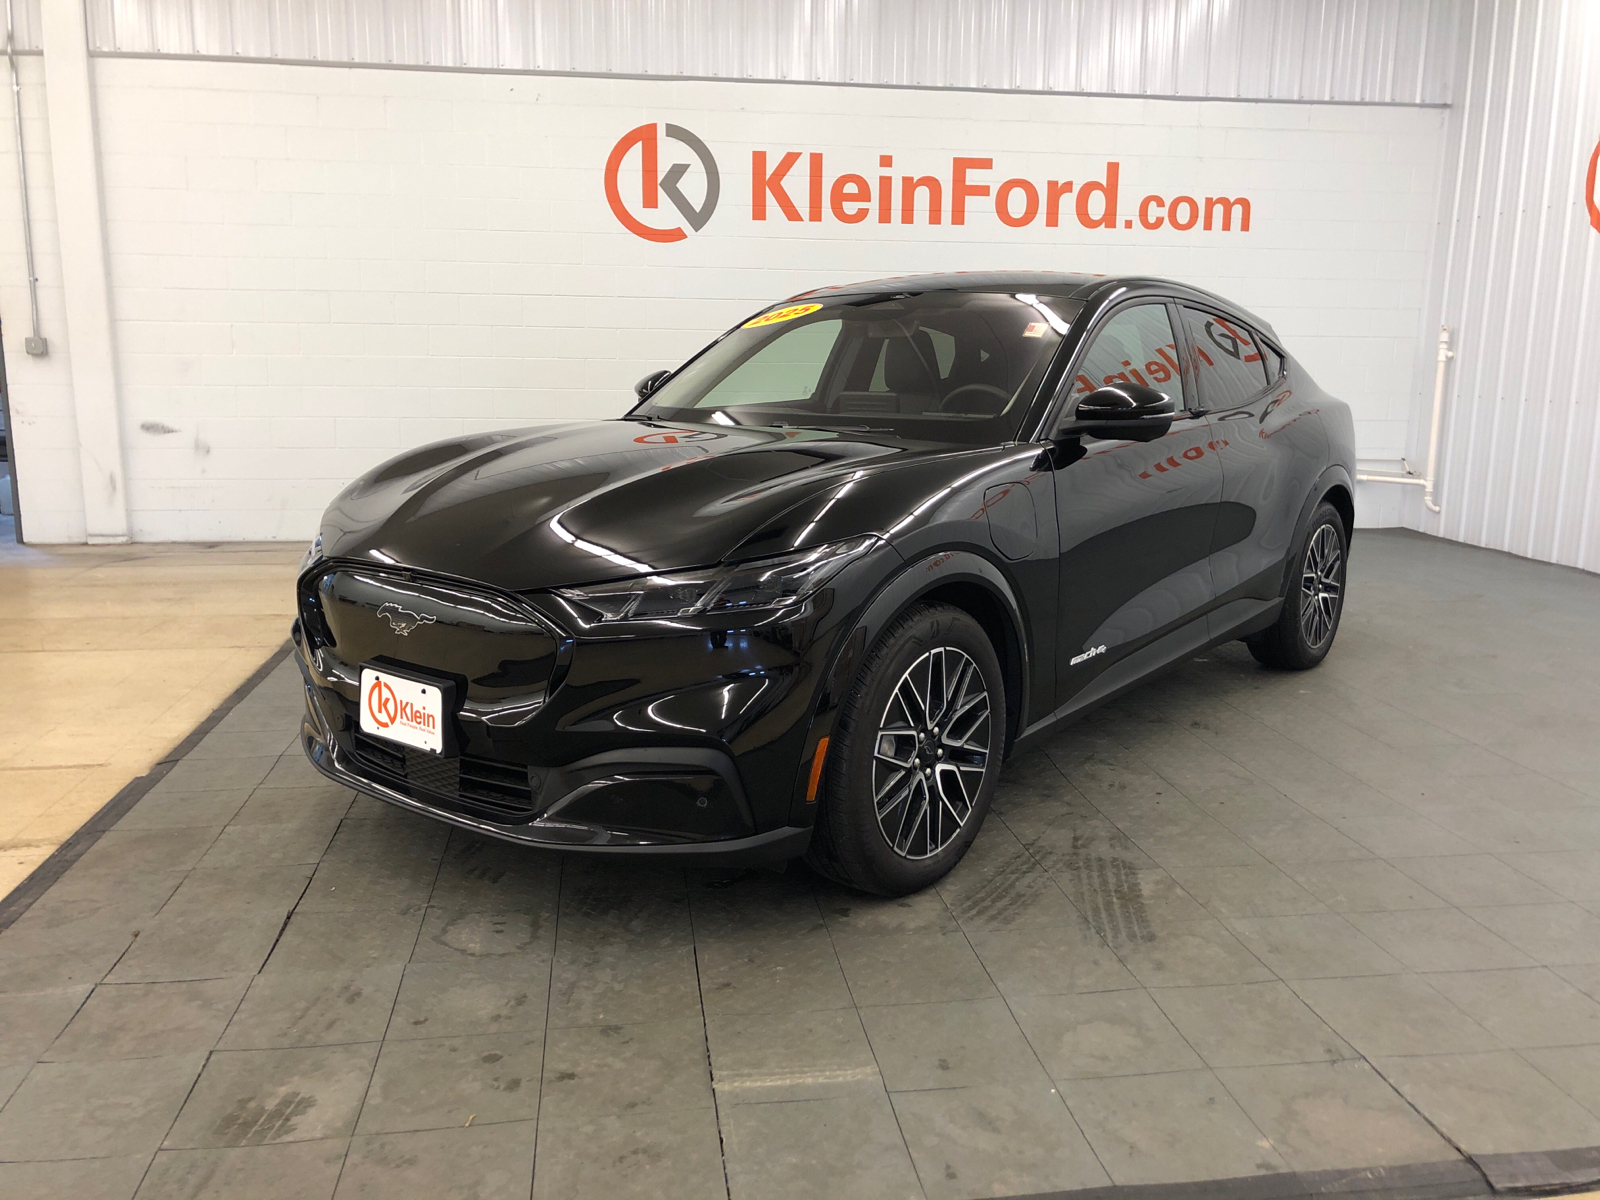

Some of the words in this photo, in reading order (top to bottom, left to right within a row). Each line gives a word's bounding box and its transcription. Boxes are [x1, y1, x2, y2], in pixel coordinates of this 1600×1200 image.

[752, 151, 1251, 232] KleinFord.com
[749, 304, 816, 327] 2025
[400, 699, 435, 730] Klein
